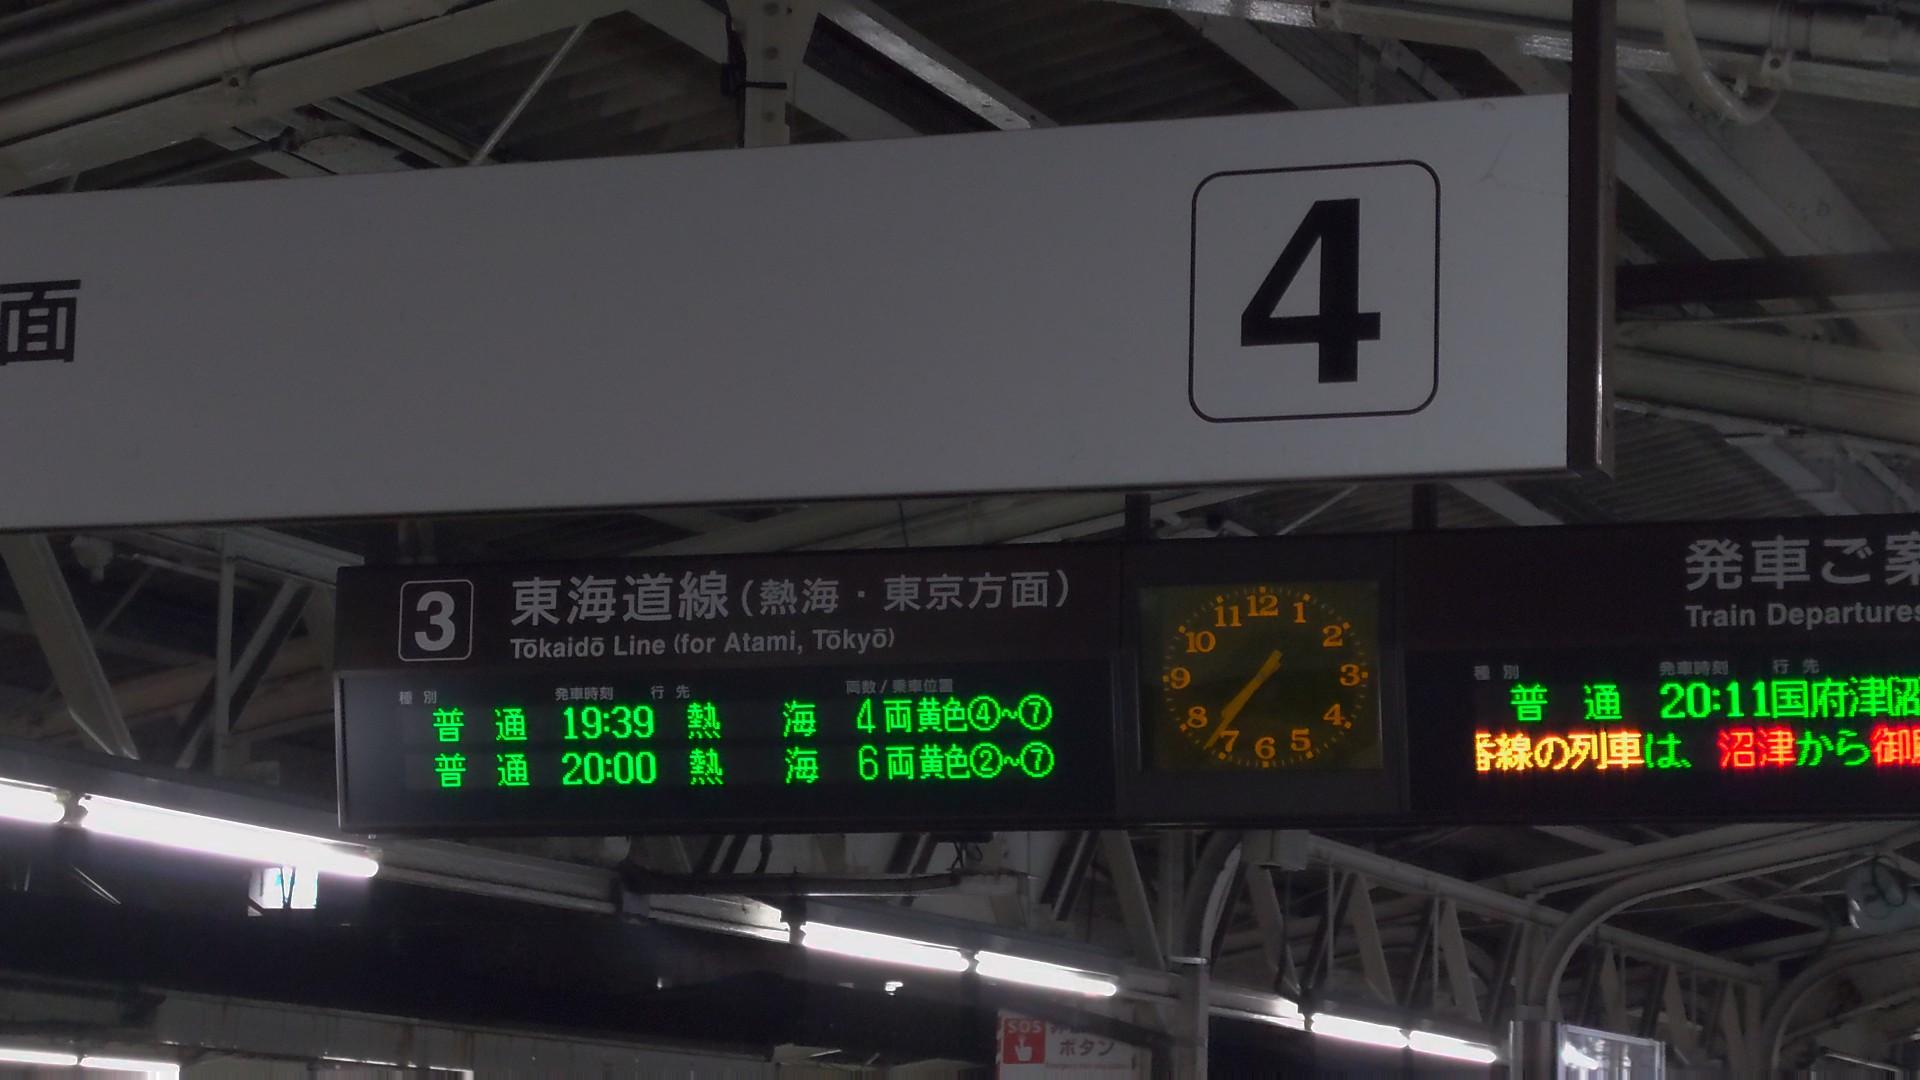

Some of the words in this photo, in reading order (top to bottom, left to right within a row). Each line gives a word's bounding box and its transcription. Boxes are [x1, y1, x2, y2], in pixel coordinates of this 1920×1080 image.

[1241, 198, 1381, 383] 4
[0, 279, 81, 366] 面
[1213, 605, 1242, 627] 11
[1247, 594, 1280, 617] 12
[1294, 601, 1307, 624] 1
[1685, 604, 1757, 628] Train
[414, 590, 456, 652] 3
[510, 636, 604, 660] Tōkaidō
[614, 635, 666, 656] Line
[674, 632, 714, 656] (for
[724, 630, 803, 655] Atami,
[812, 627, 896, 654] Tōkyō)
[1185, 630, 1217, 653] 10
[1322, 624, 1343, 647] 2
[1170, 667, 1191, 690] 9
[1339, 663, 1360, 687] 3
[1659, 681, 1770, 718] 20:11
[563, 705, 656, 740] 19:39
[1187, 706, 1208, 728] 8
[1323, 703, 1345, 725] 4
[1219, 730, 1240, 753] 7
[1255, 736, 1276, 760] 6
[1290, 728, 1312, 751] 5
[561, 751, 658, 786] 20:00
[1007, 1019, 1042, 1034] SOS
[1059, 1039, 1115, 1057] ボタン
